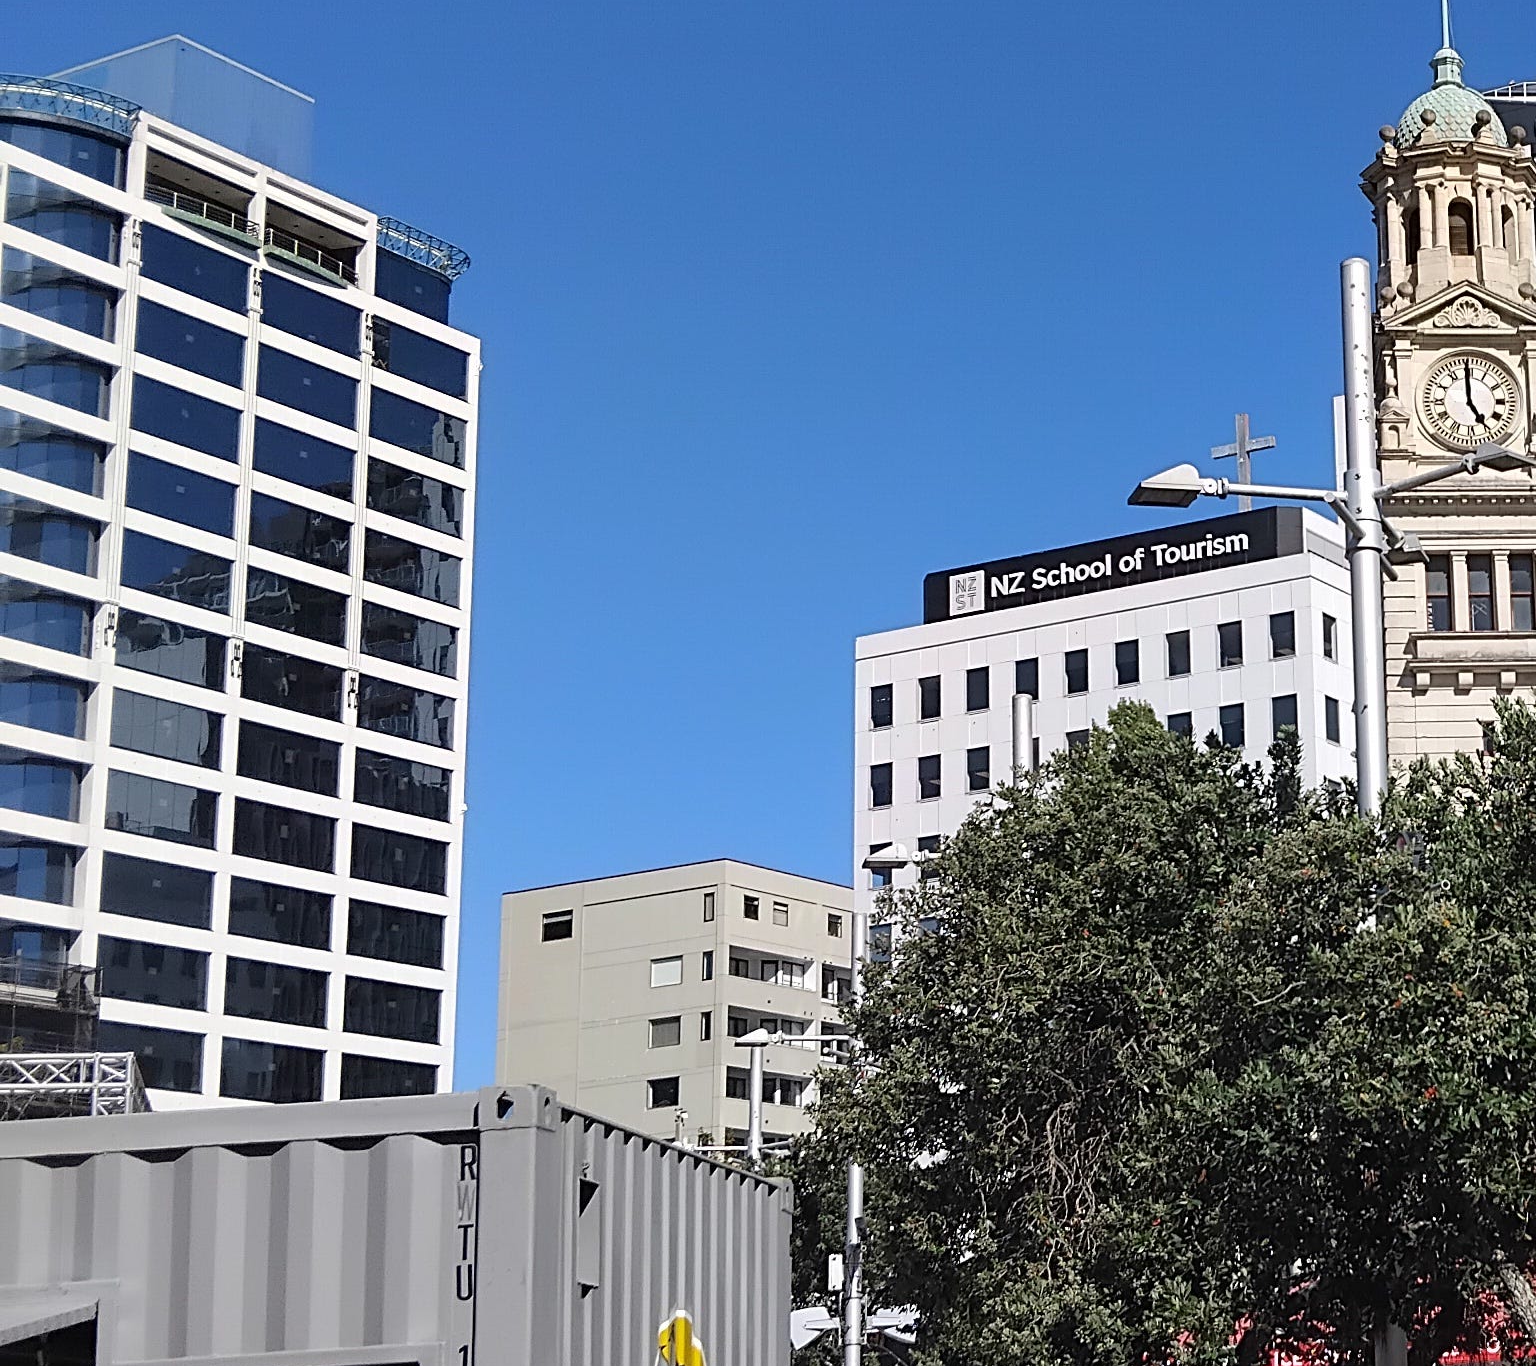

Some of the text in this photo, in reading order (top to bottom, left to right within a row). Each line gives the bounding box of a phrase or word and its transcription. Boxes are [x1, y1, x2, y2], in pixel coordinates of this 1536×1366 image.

[955, 576, 977, 594] NZ
[991, 532, 1249, 598] NZ School of Tourism
[955, 592, 977, 611] ST
[456, 1145, 477, 1301] RWTU
